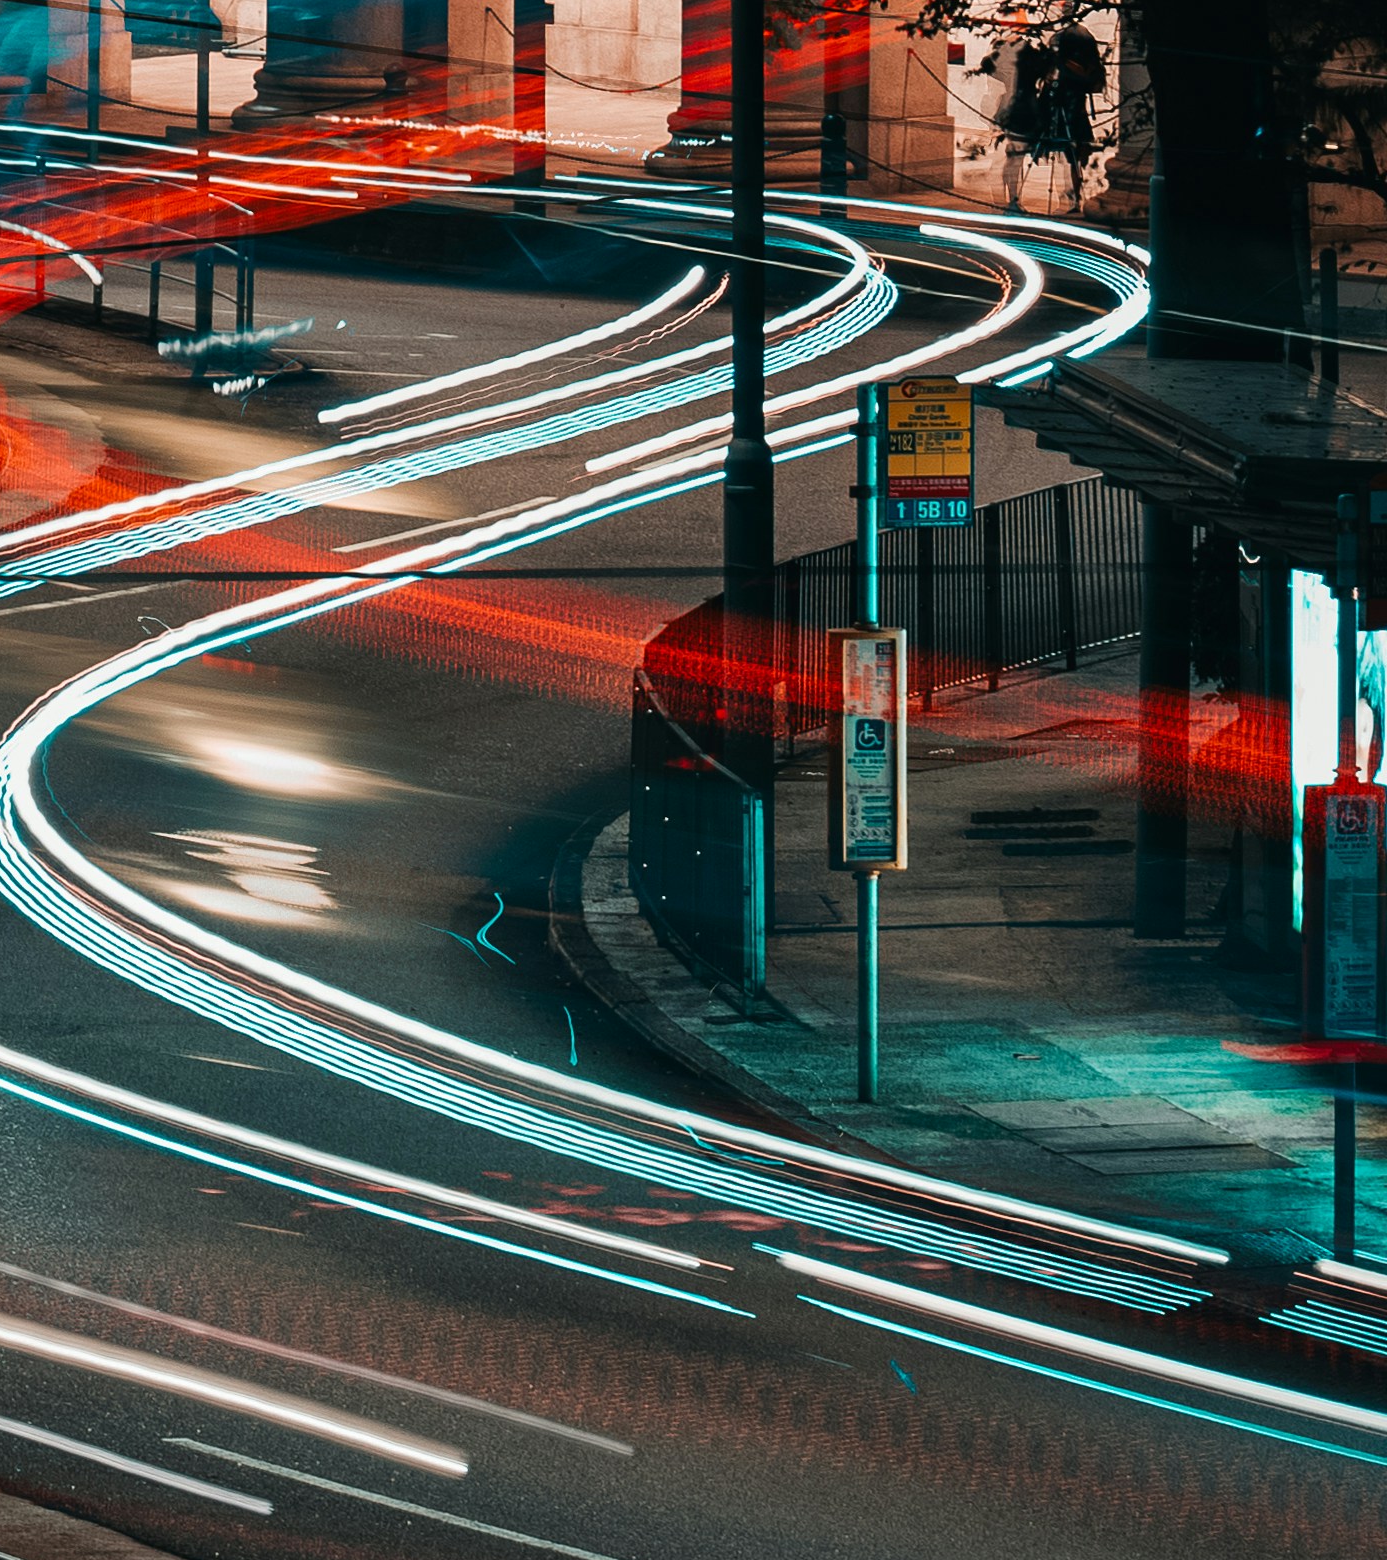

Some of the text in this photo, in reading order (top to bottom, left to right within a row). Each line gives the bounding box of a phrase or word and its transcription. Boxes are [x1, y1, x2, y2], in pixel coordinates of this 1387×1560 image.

[897, 500, 967, 519] 1 5B 10
